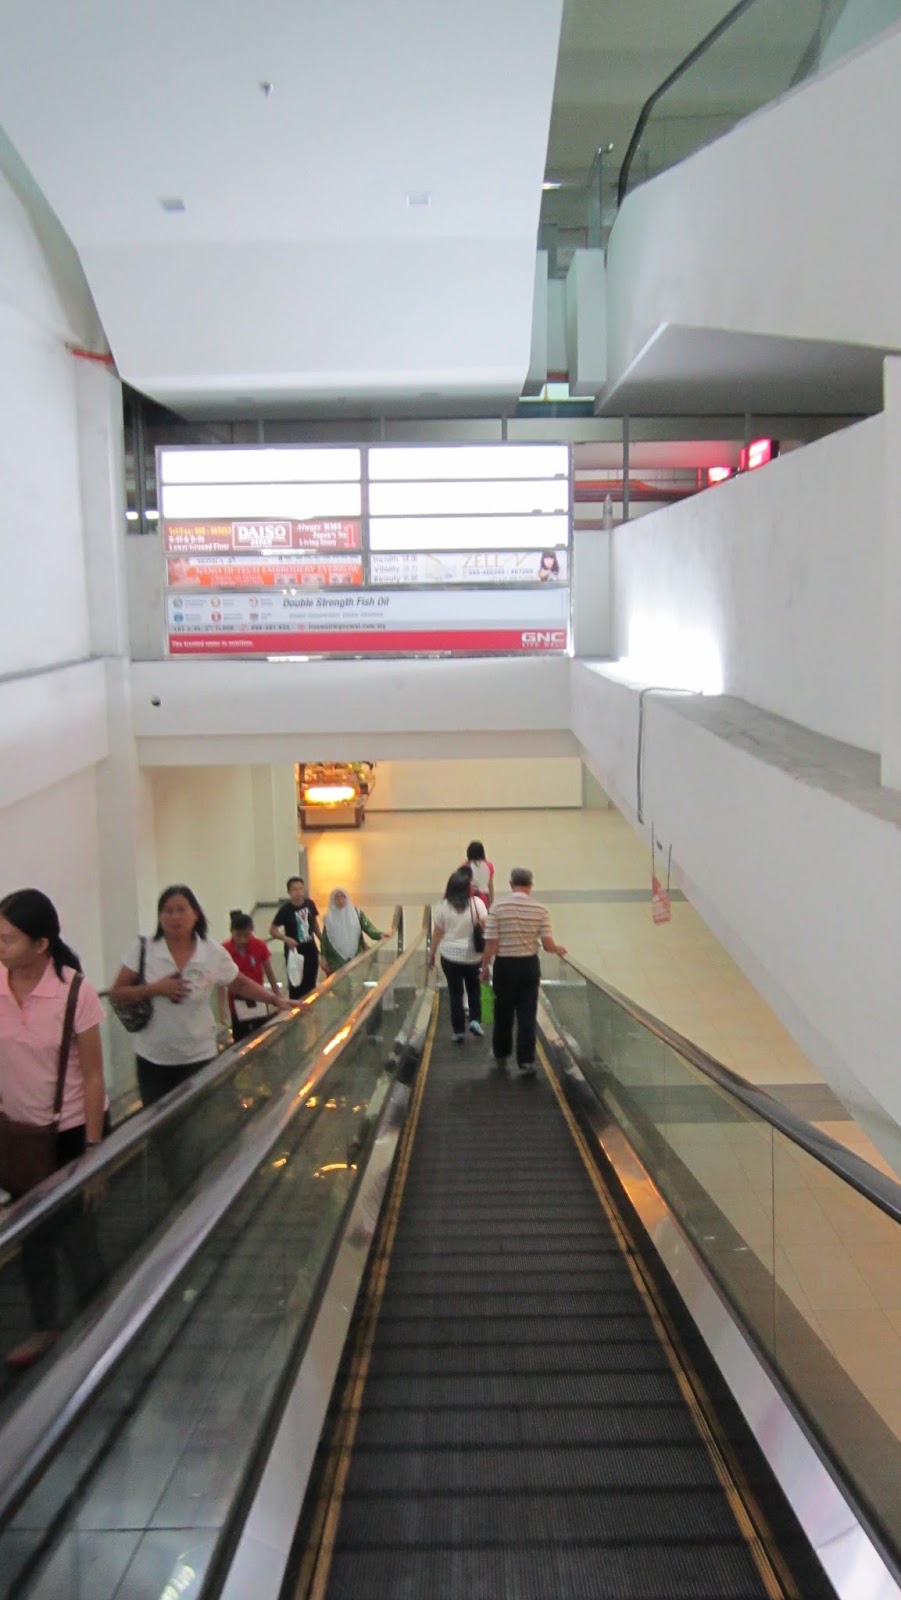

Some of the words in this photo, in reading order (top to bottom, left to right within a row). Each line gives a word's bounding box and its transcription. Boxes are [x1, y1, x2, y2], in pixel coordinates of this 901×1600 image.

[238, 525, 286, 538] DAISO
[283, 598, 314, 608] Double
[316, 597, 354, 609] Strength
[356, 596, 375, 607] Fish
[377, 596, 390, 607] Oil
[522, 632, 565, 642] GNC
